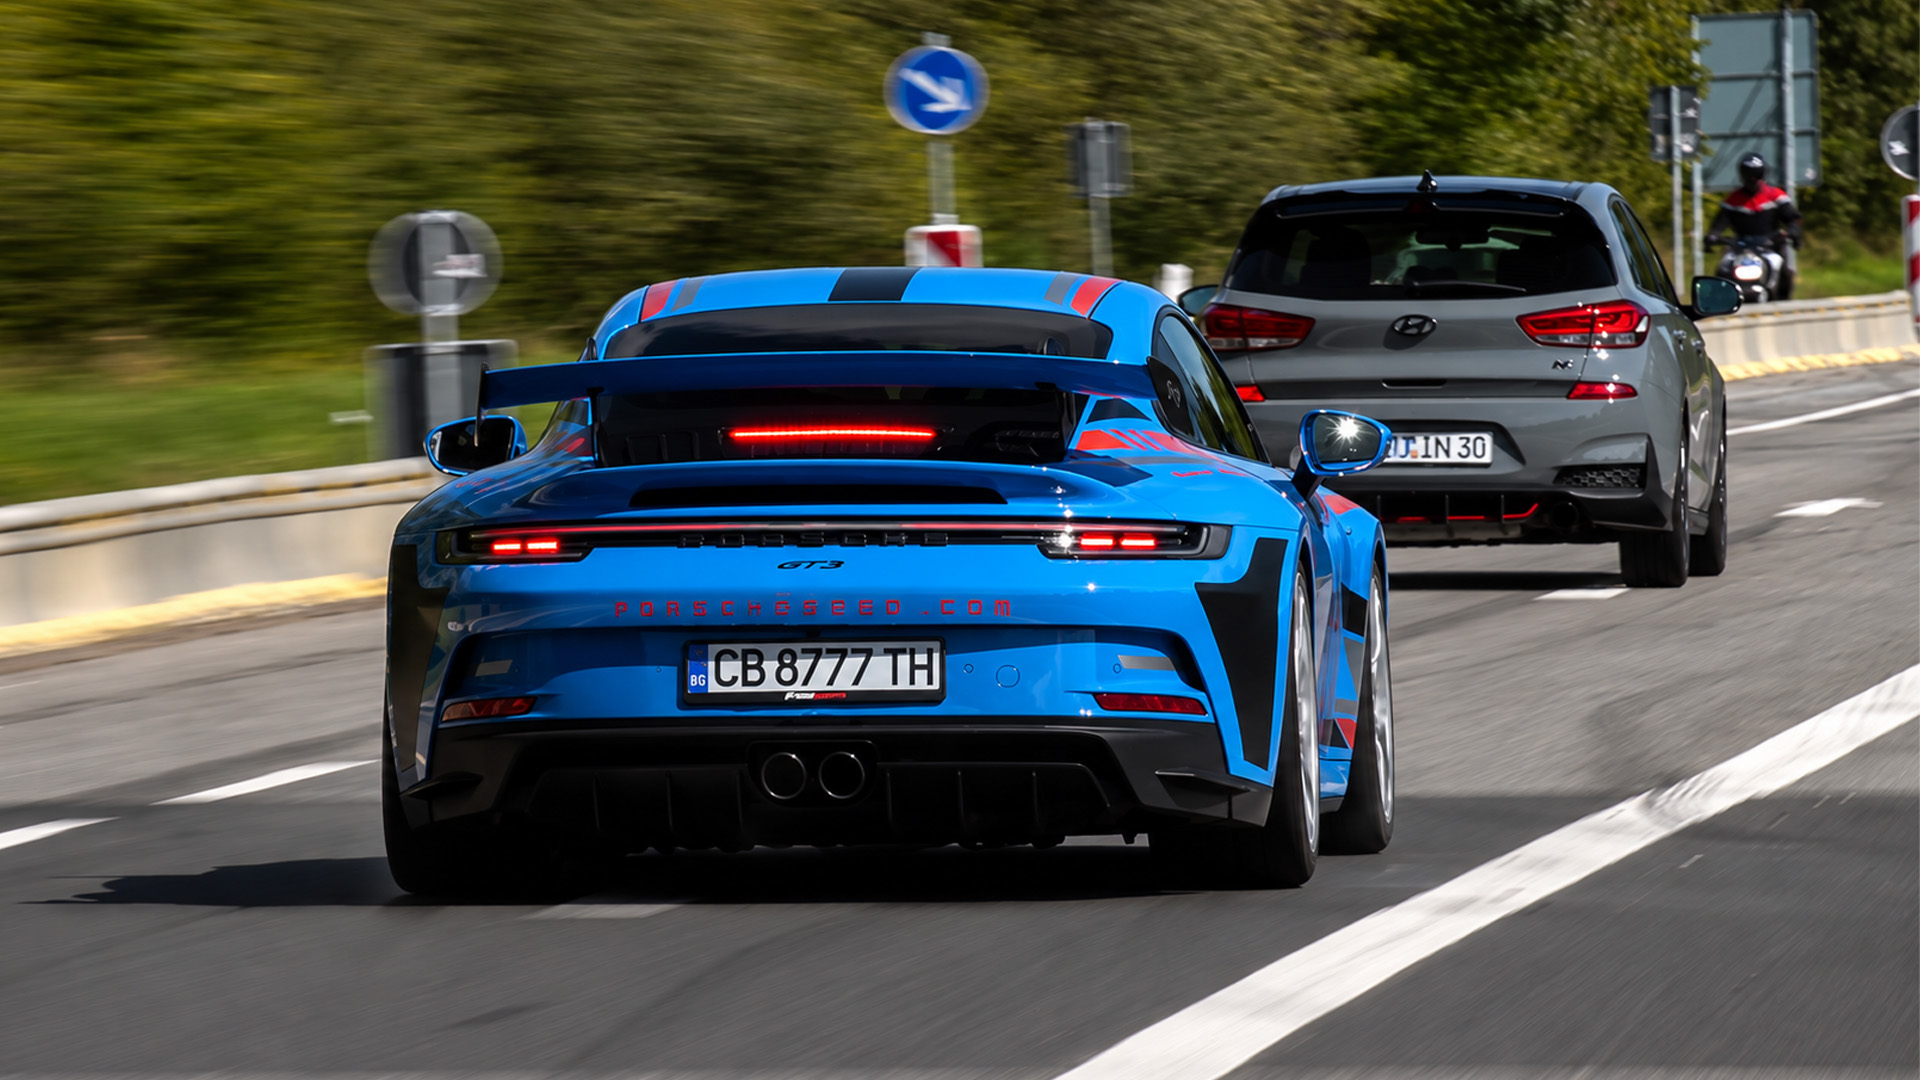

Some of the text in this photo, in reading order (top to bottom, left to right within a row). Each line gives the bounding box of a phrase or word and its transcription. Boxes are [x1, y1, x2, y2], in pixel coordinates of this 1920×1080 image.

[1421, 435, 1451, 459] IN
[1458, 435, 1486, 459] 30
[777, 560, 845, 570] GT3
[714, 647, 934, 687] CB 8777 TH
[690, 674, 706, 687] BG
